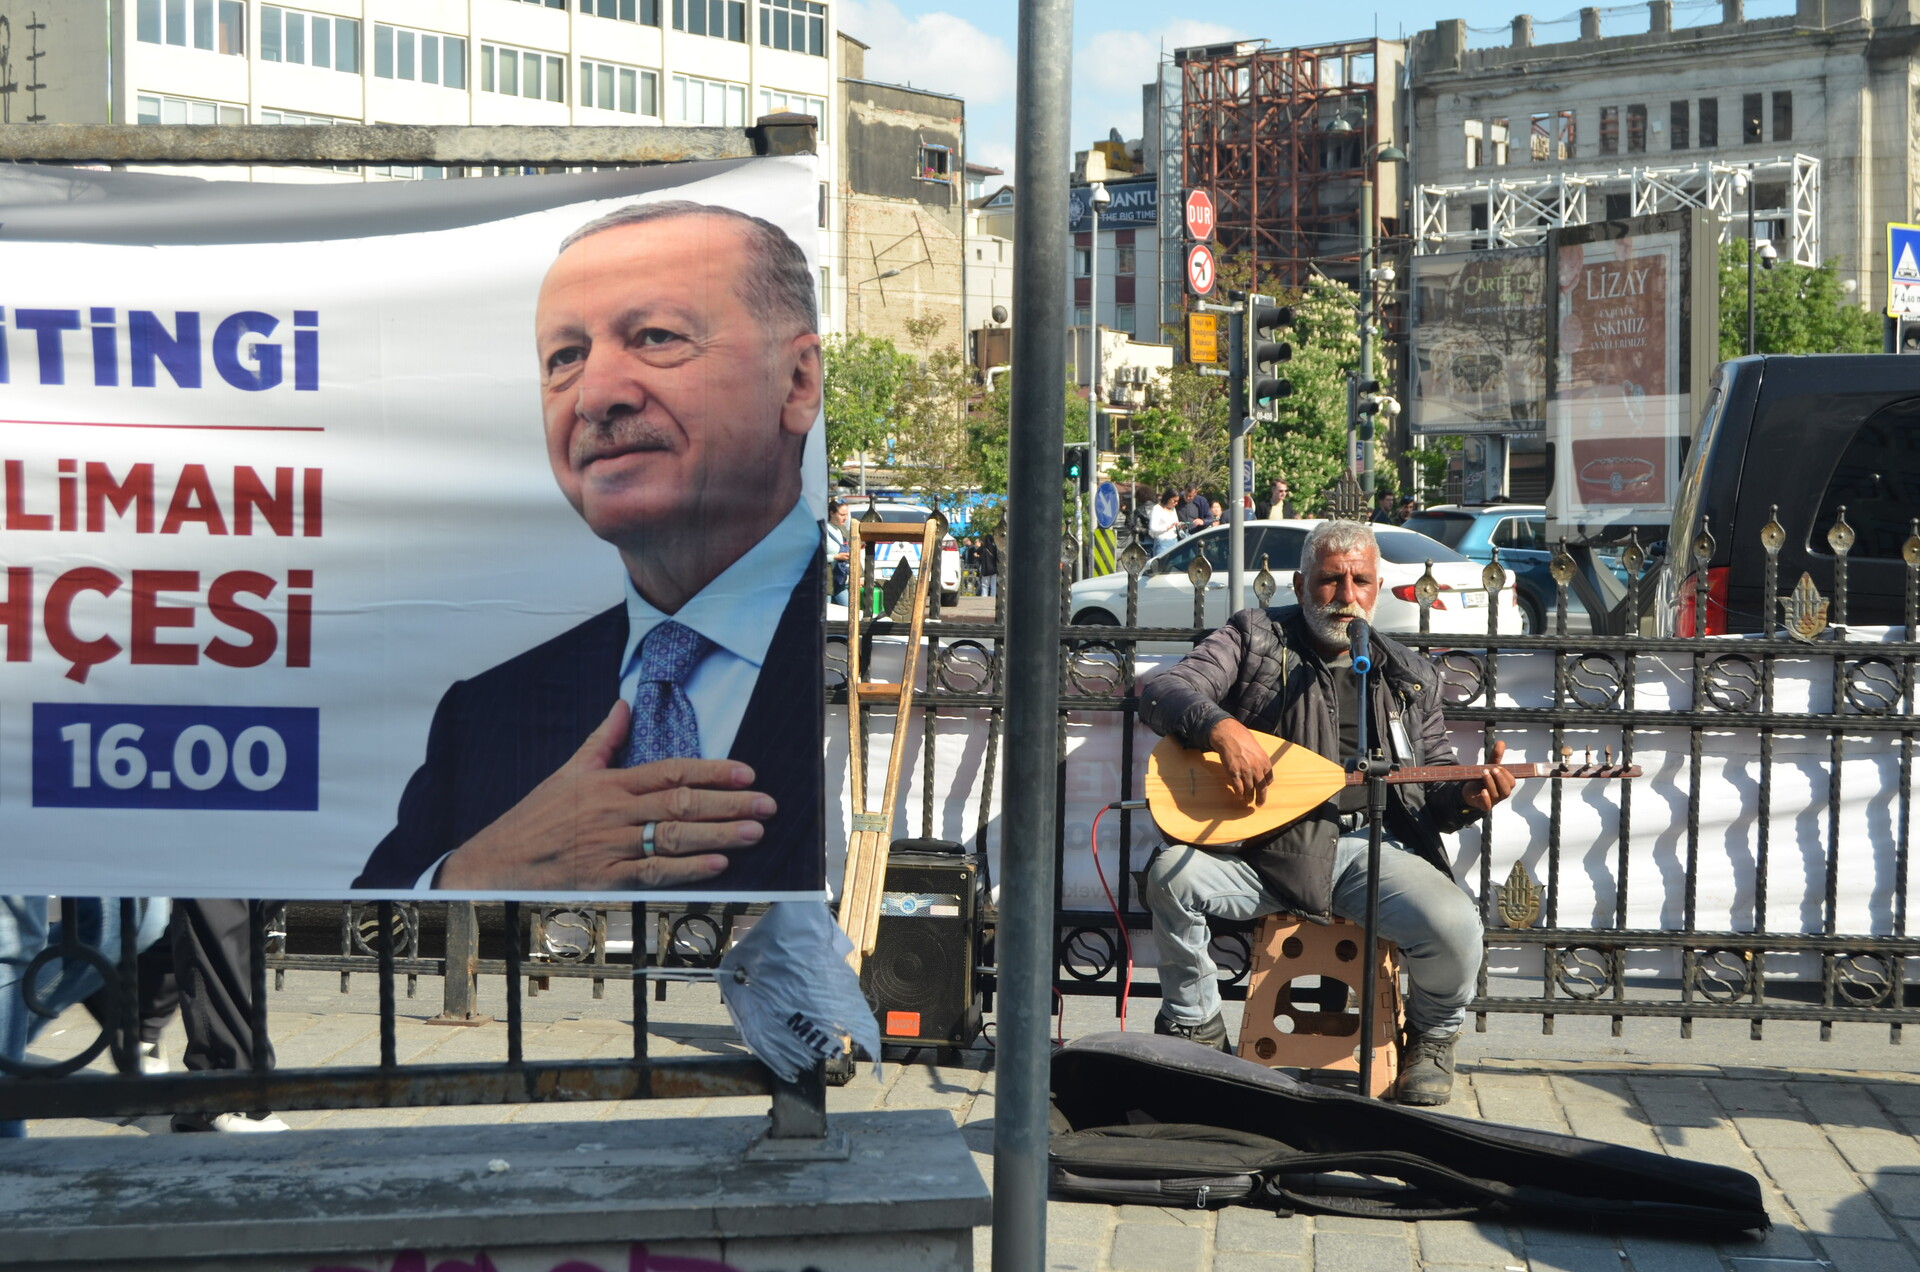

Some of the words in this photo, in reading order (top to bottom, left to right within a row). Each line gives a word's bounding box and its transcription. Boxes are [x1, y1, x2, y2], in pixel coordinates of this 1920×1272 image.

[1101, 213, 1118, 222] THE
[1119, 211, 1134, 220] BIG
[1136, 209, 1157, 219] TIME
[1189, 205, 1211, 225] DUR
[1464, 274, 1511, 295] CARTE
[1586, 266, 1650, 300] LİZAY
[0, 459, 323, 537] LİMANI
[61, 722, 287, 792] 16.00
